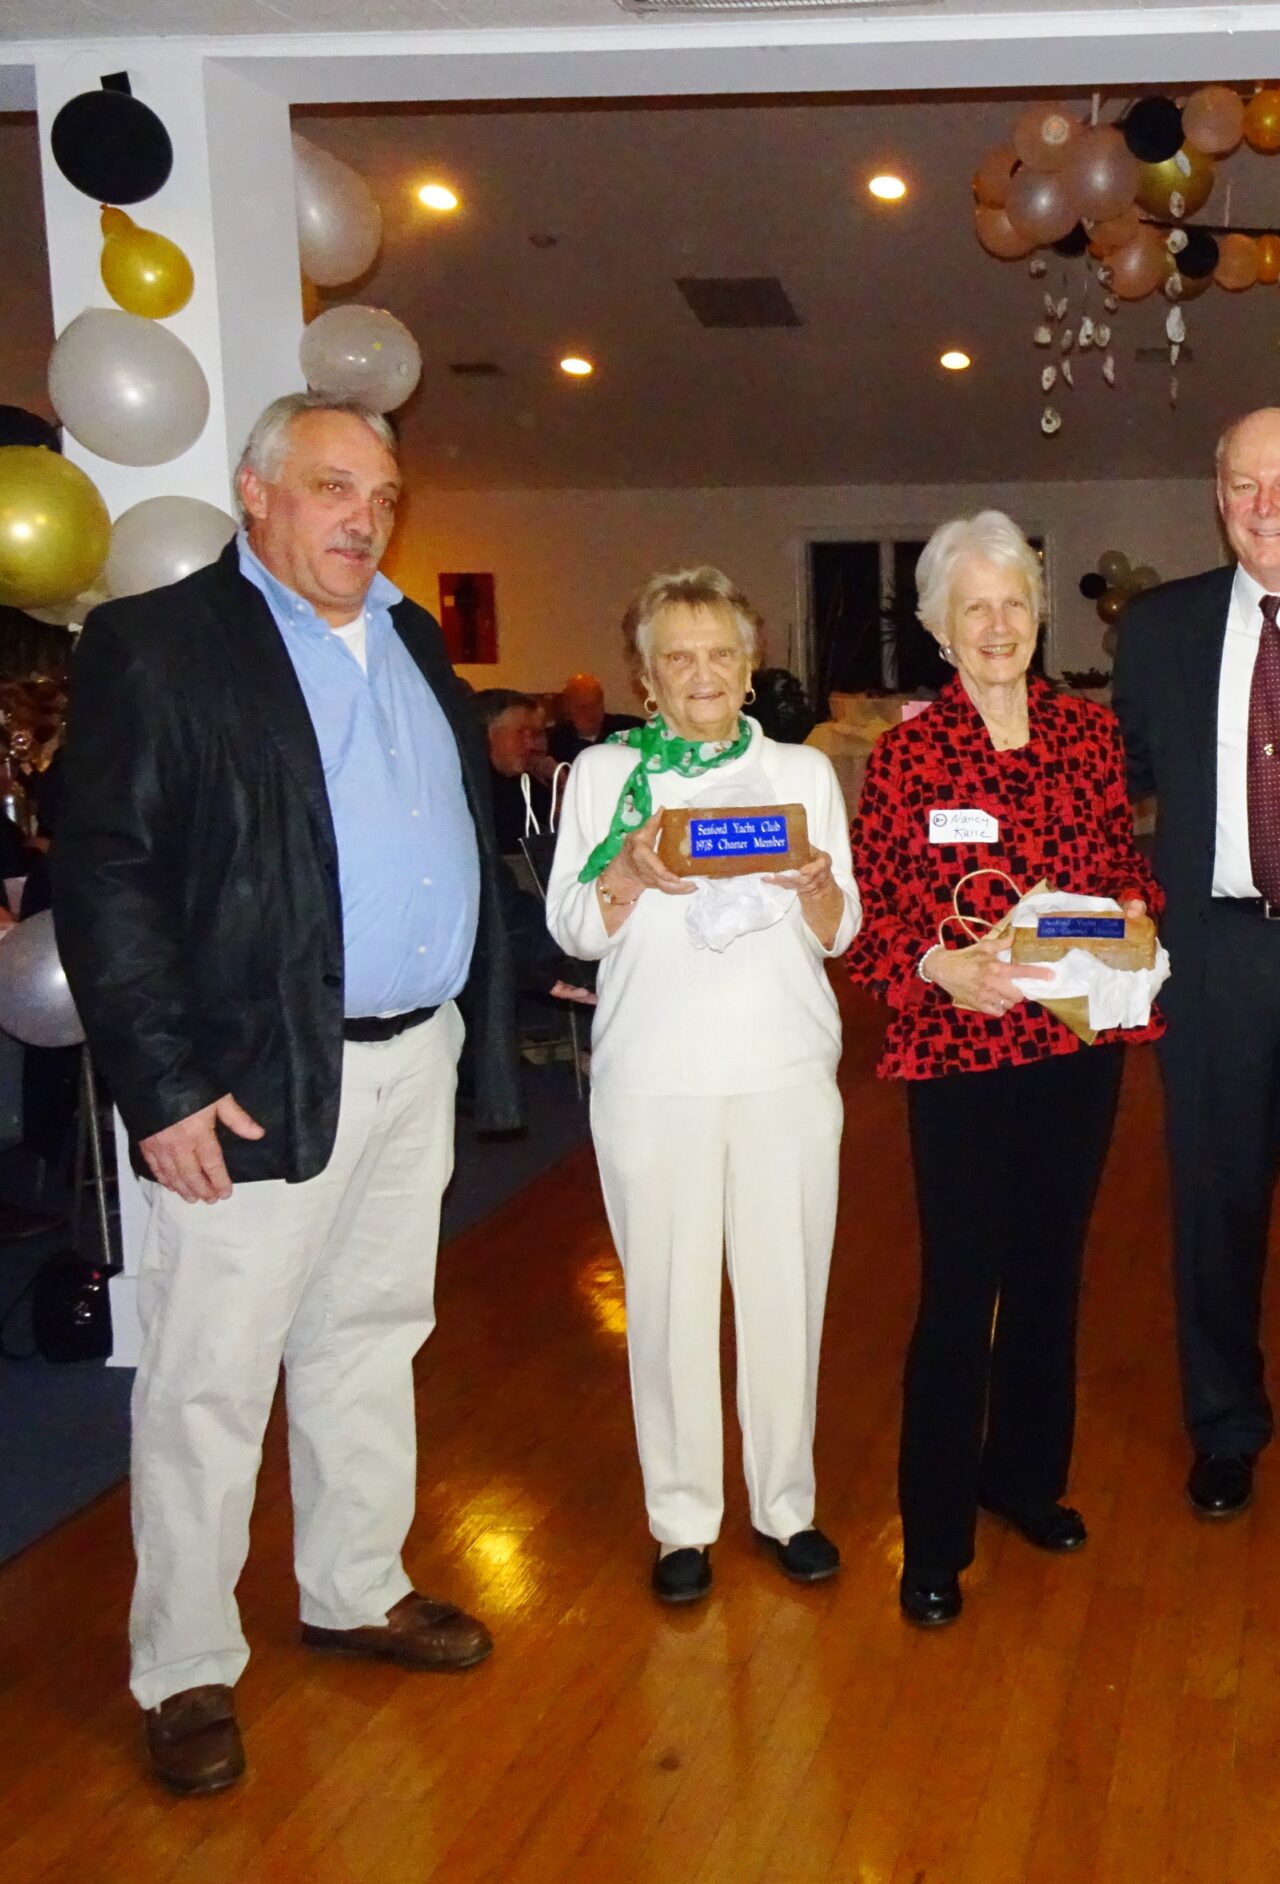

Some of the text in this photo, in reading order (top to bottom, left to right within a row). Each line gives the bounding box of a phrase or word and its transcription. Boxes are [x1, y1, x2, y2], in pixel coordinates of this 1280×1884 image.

[697, 819, 781, 836] Seaford Yacht Club
[717, 838, 748, 850] Charter
[753, 835, 786, 848] Member
